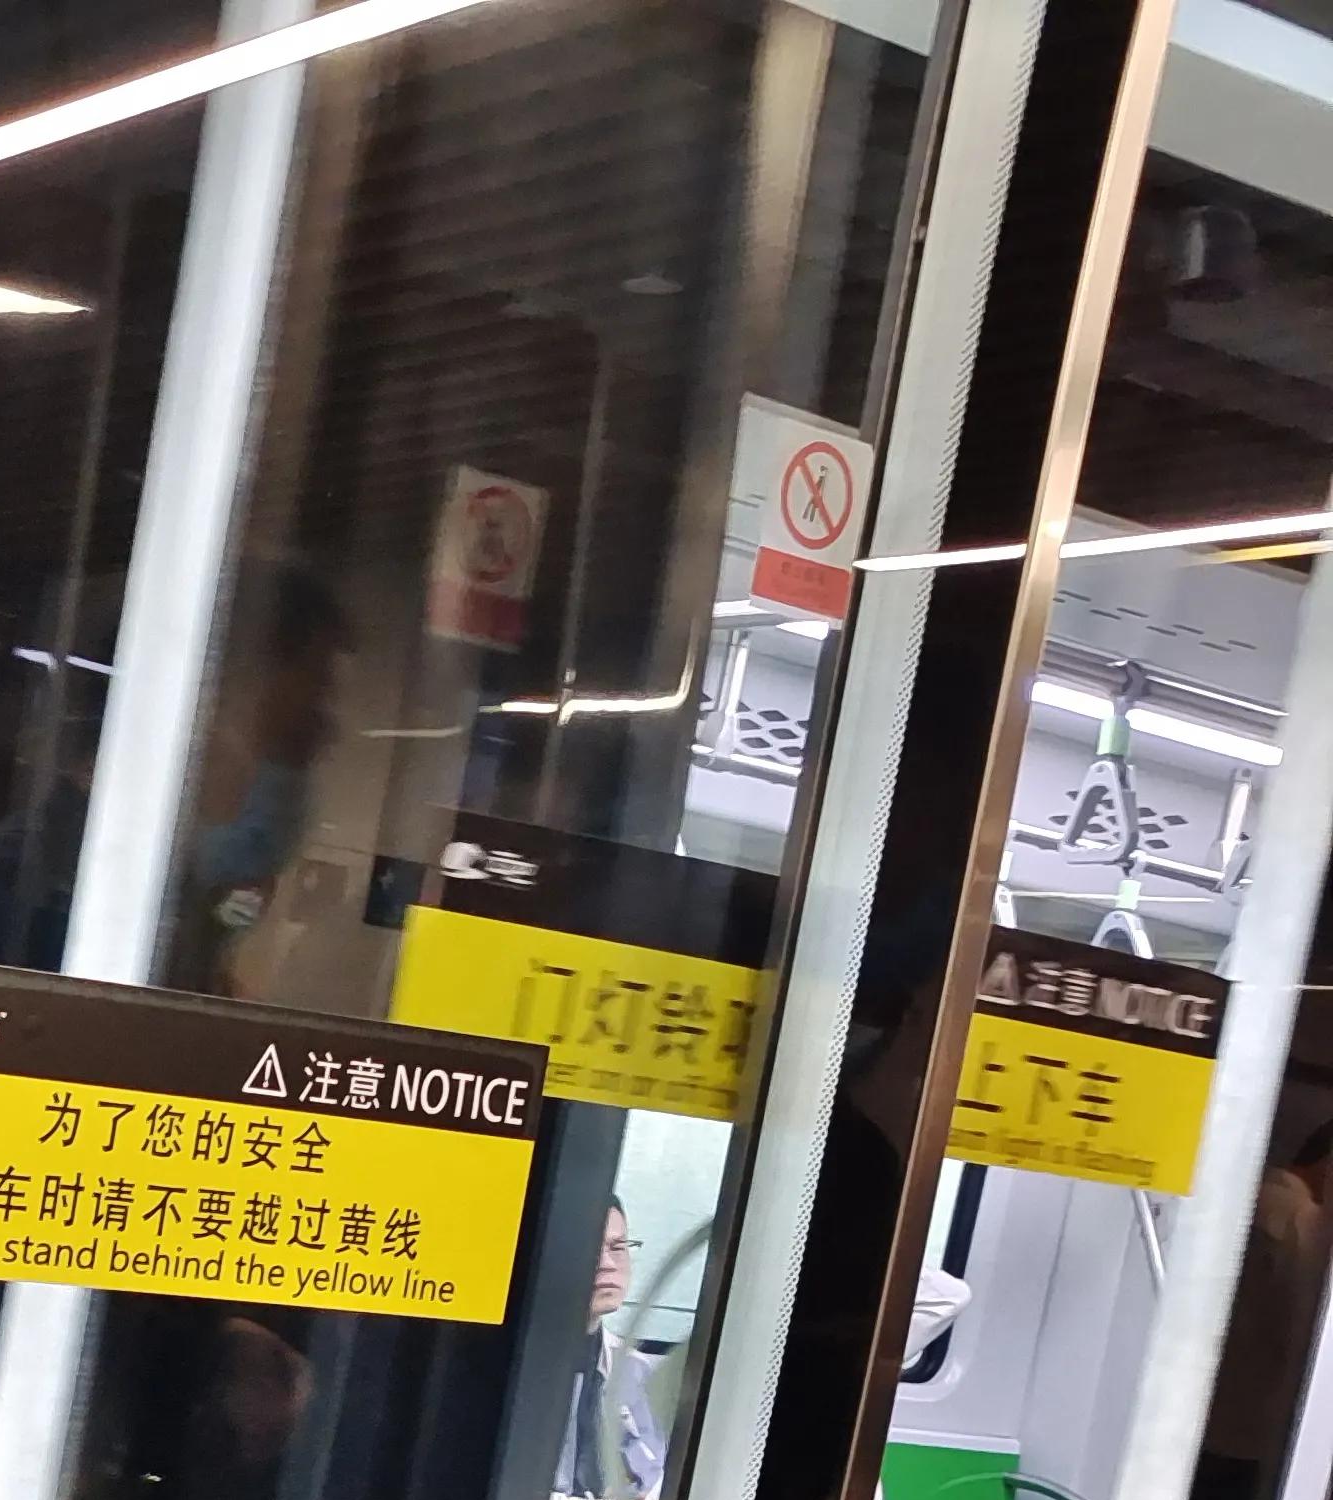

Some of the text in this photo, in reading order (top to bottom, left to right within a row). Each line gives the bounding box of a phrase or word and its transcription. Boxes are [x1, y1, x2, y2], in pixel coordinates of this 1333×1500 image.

[298, 1050, 386, 1111] 注意
[389, 1063, 530, 1127] NOTICE
[38, 1090, 333, 1174] 为了您的安全
[1, 1236, 99, 1271] stand
[108, 1239, 225, 1282] behind
[234, 1252, 285, 1288] the
[291, 1261, 394, 1299] yellow
[402, 1267, 456, 1304] line
